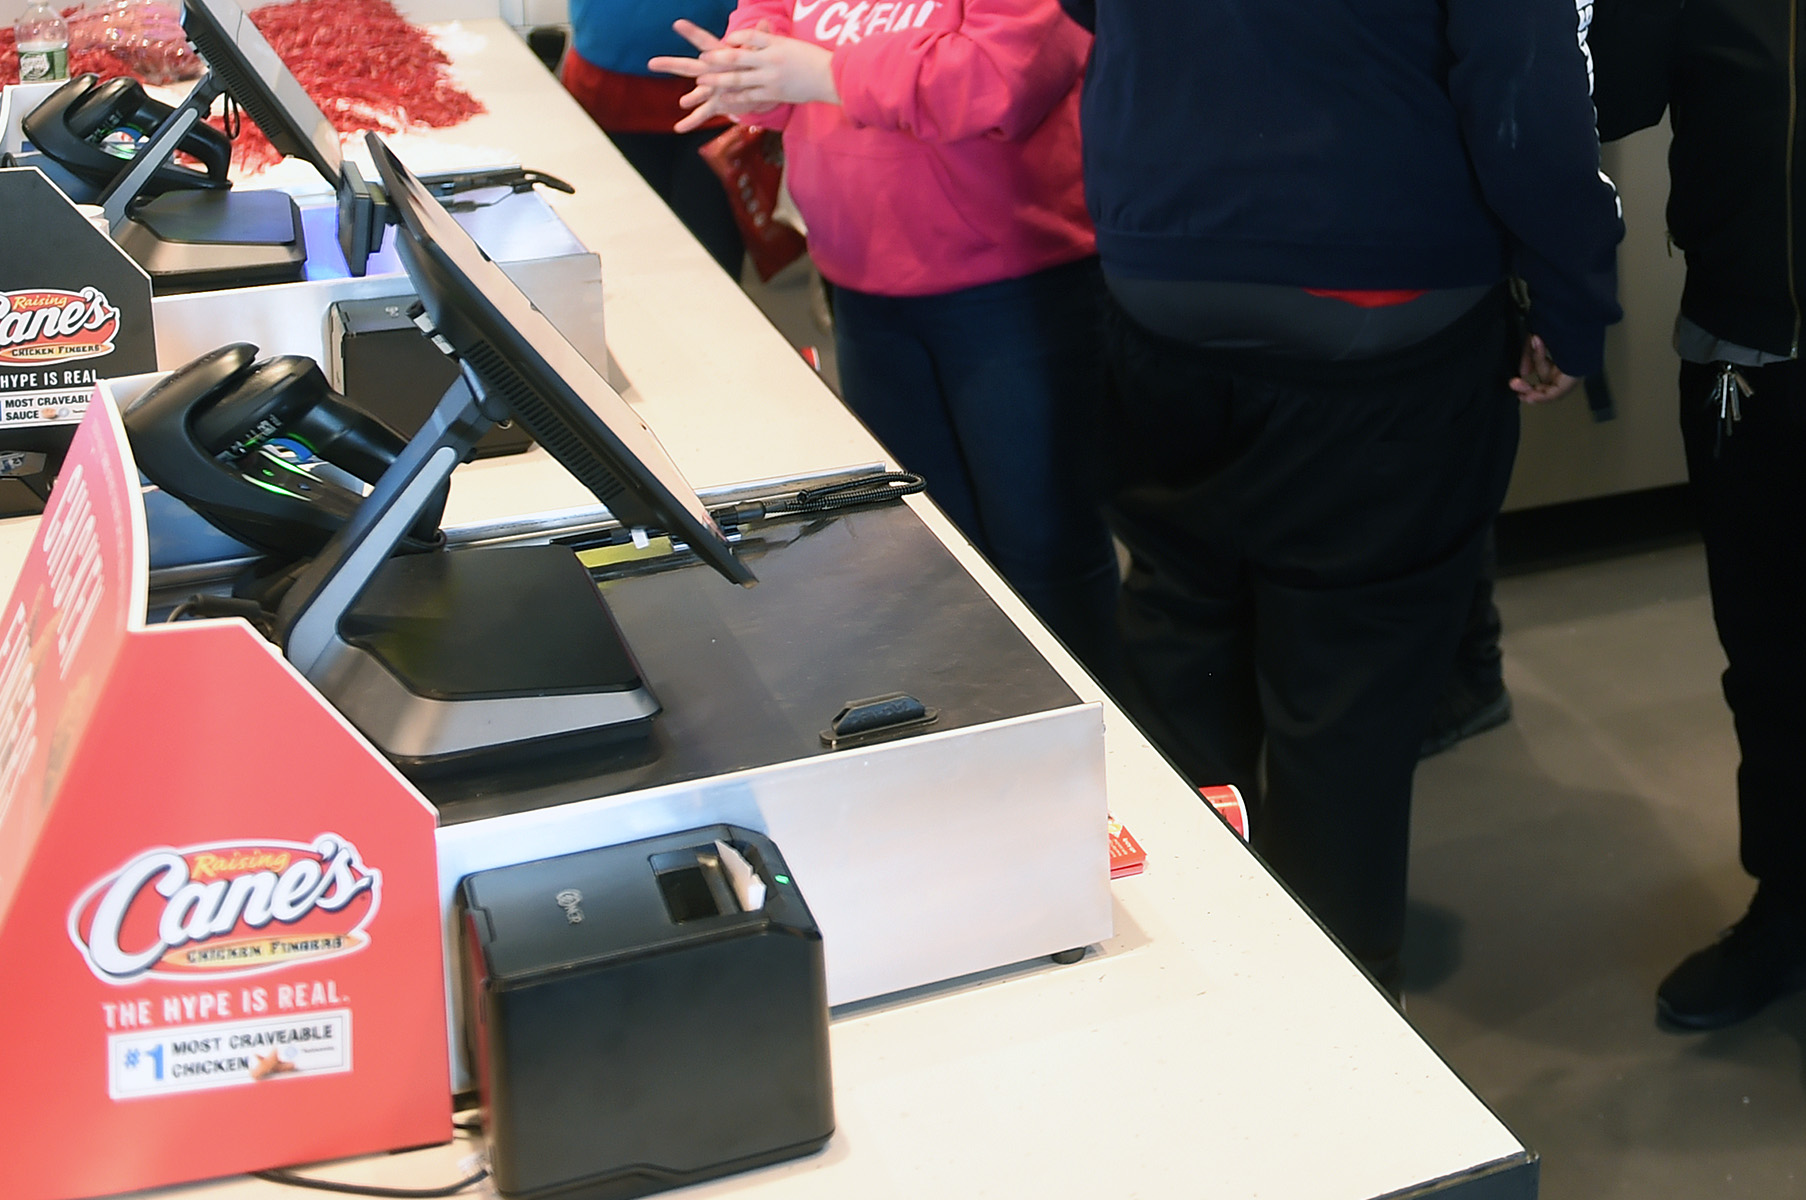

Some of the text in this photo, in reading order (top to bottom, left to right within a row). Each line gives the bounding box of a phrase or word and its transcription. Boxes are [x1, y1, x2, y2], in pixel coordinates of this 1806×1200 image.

[13, 294, 68, 310] Raising
[0, 290, 115, 346] ane's
[12, 344, 100, 357] CHICKEN FINGERS
[0, 373, 38, 389] HYPE
[44, 372, 58, 386] IS
[5, 398, 34, 409] MOST
[6, 410, 39, 421] SAUCE
[190, 849, 291, 879] Raising
[88, 839, 375, 976] Cane's
[187, 936, 344, 963] CHICKEN FINGERS
[102, 979, 350, 1029] THE HYPE IS REAL.
[124, 1024, 334, 1081] #1 MOST CRAVEABLE
[172, 1056, 249, 1079] CHICKEN
